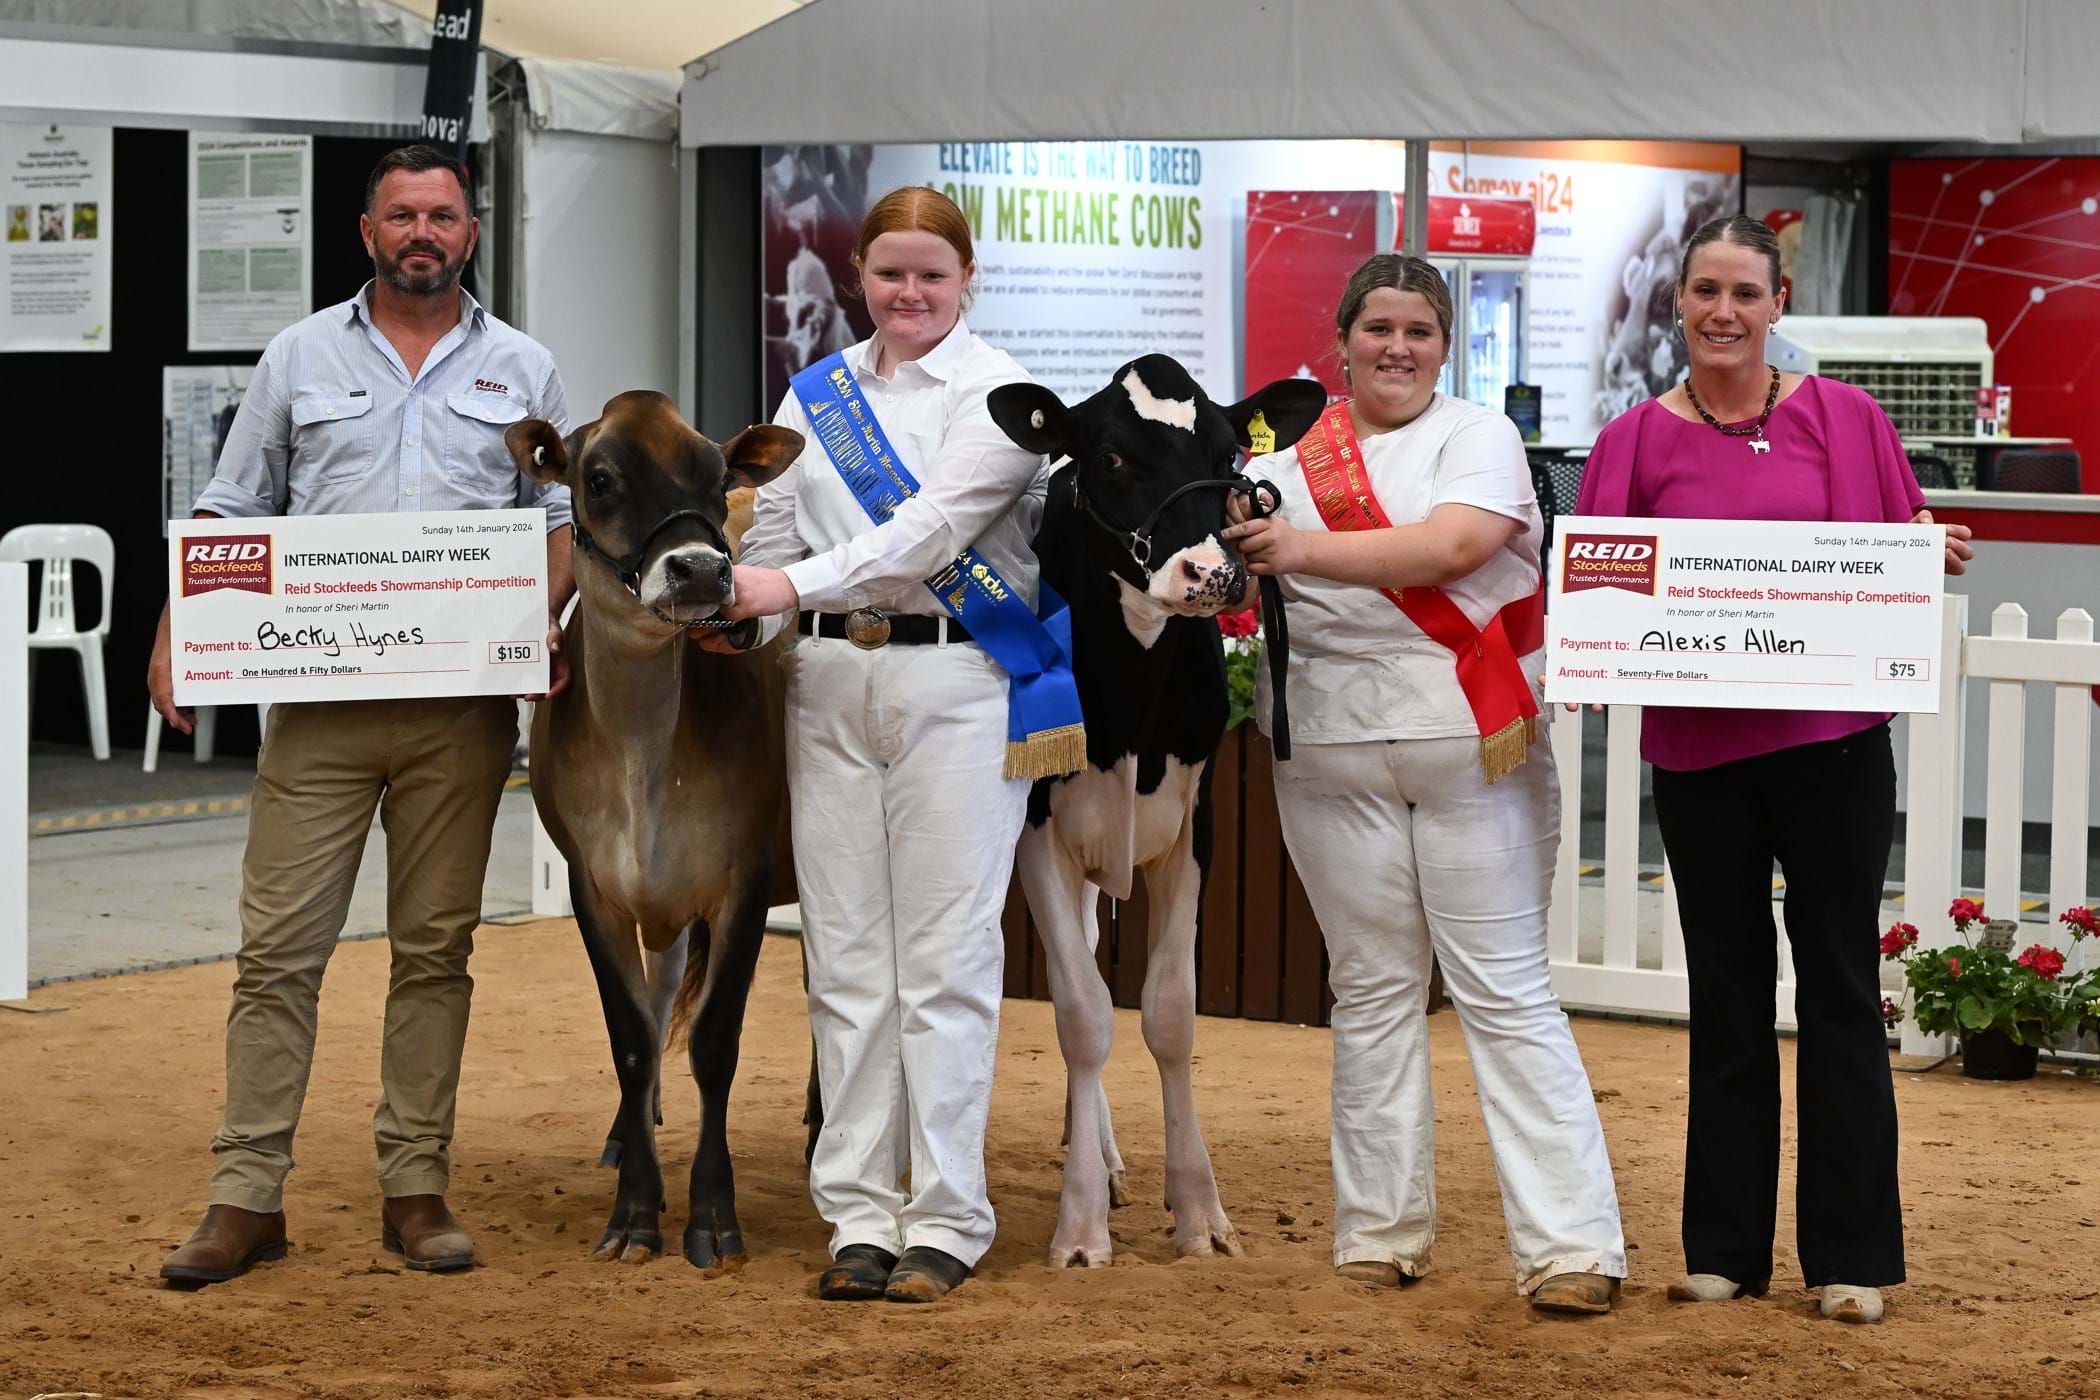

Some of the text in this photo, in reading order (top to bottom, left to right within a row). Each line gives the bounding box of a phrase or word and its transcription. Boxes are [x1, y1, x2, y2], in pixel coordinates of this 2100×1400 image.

[433, 8, 471, 39] ead
[420, 114, 464, 142] nova
[940, 142, 1201, 186] ELEVATE IS THE WAY TO BREED
[997, 186, 1120, 245] METHANE
[1131, 193, 1203, 250] COWS
[474, 378, 508, 391] REID
[815, 406, 883, 500] INTERMEDIATE
[422, 523, 533, 535] Sunday 14th January 2024
[1814, 537, 1931, 548] Sunday 14th January 2024
[185, 543, 267, 562] REID
[284, 548, 491, 567] INTERNATIONAL DAIRY WEEK
[1568, 542, 1653, 560] REID
[189, 561, 264, 574] Stockfeeds
[1571, 560, 1648, 573] Stockfeeds
[1669, 557, 1884, 574] INTERNATIONAL DAIRY WEEK
[187, 575, 267, 585] Trusted Performance
[285, 576, 536, 595] Reid Stockfeeds Showmanship Competition
[1568, 574, 1650, 584] Trusted Performance
[1667, 586, 1931, 605] Reid Stockfeeds Showmanship Competition
[285, 602, 389, 613] In honor of Sheri Martin
[1666, 608, 1775, 619] In honor of Sheri Martin
[257, 621, 424, 657] Becky Hynes
[1560, 638, 1630, 651] Payment to:
[1639, 627, 1805, 654] Alexis Allen
[184, 641, 252, 654] Payment to:
[497, 645, 531, 662] $150
[185, 665, 362, 681] Amount: One Hundred & Fifty Dollars
[1558, 666, 1709, 680] Amount: Seventy-Five Dollars
[1889, 662, 1916, 678] $75
